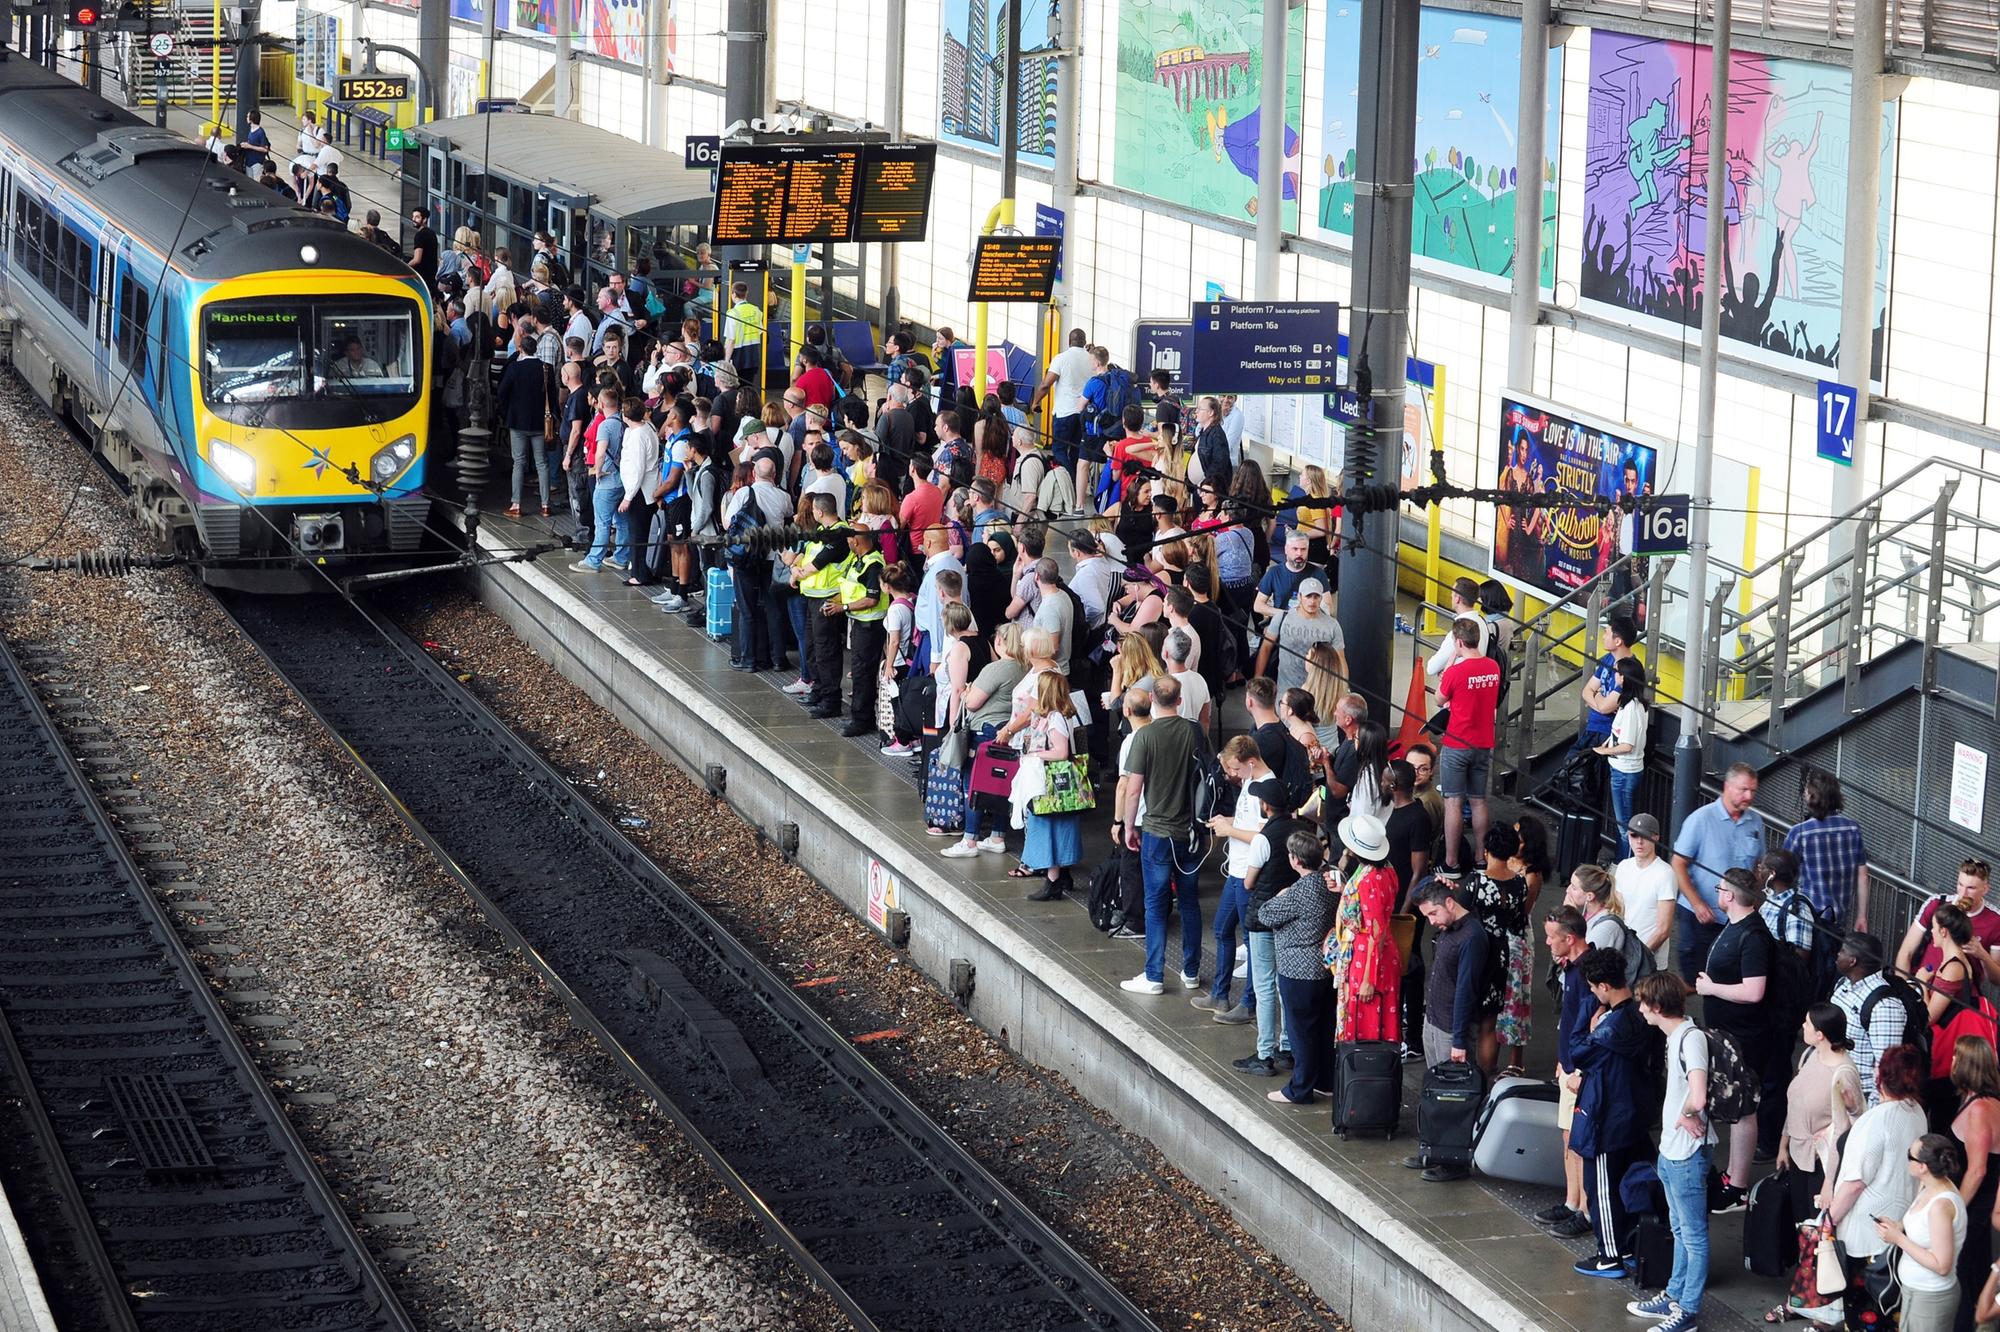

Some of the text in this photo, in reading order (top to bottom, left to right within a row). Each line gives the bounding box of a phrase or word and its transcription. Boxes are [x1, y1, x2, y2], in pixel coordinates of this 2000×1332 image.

[155, 39, 170, 52] 25
[687, 141, 719, 162] 16a
[1230, 305, 1274, 314] Platform 17
[210, 312, 298, 323] Manchester
[1230, 321, 1279, 330] Platform 16a
[1254, 344, 1303, 353] Platform 16b
[1240, 360, 1277, 369] Platforms
[1283, 361, 1292, 369] to
[1293, 361, 1302, 369] 15
[1268, 376, 1301, 386] Way out
[1340, 395, 1360, 418] Leed
[1823, 392, 1850, 436] 17
[1543, 422, 1620, 466] LOVE IS IN THE AIR
[1556, 461, 1597, 496] STRICTLY
[1642, 506, 1688, 541] 16a
[1467, 674, 1499, 684] macron
